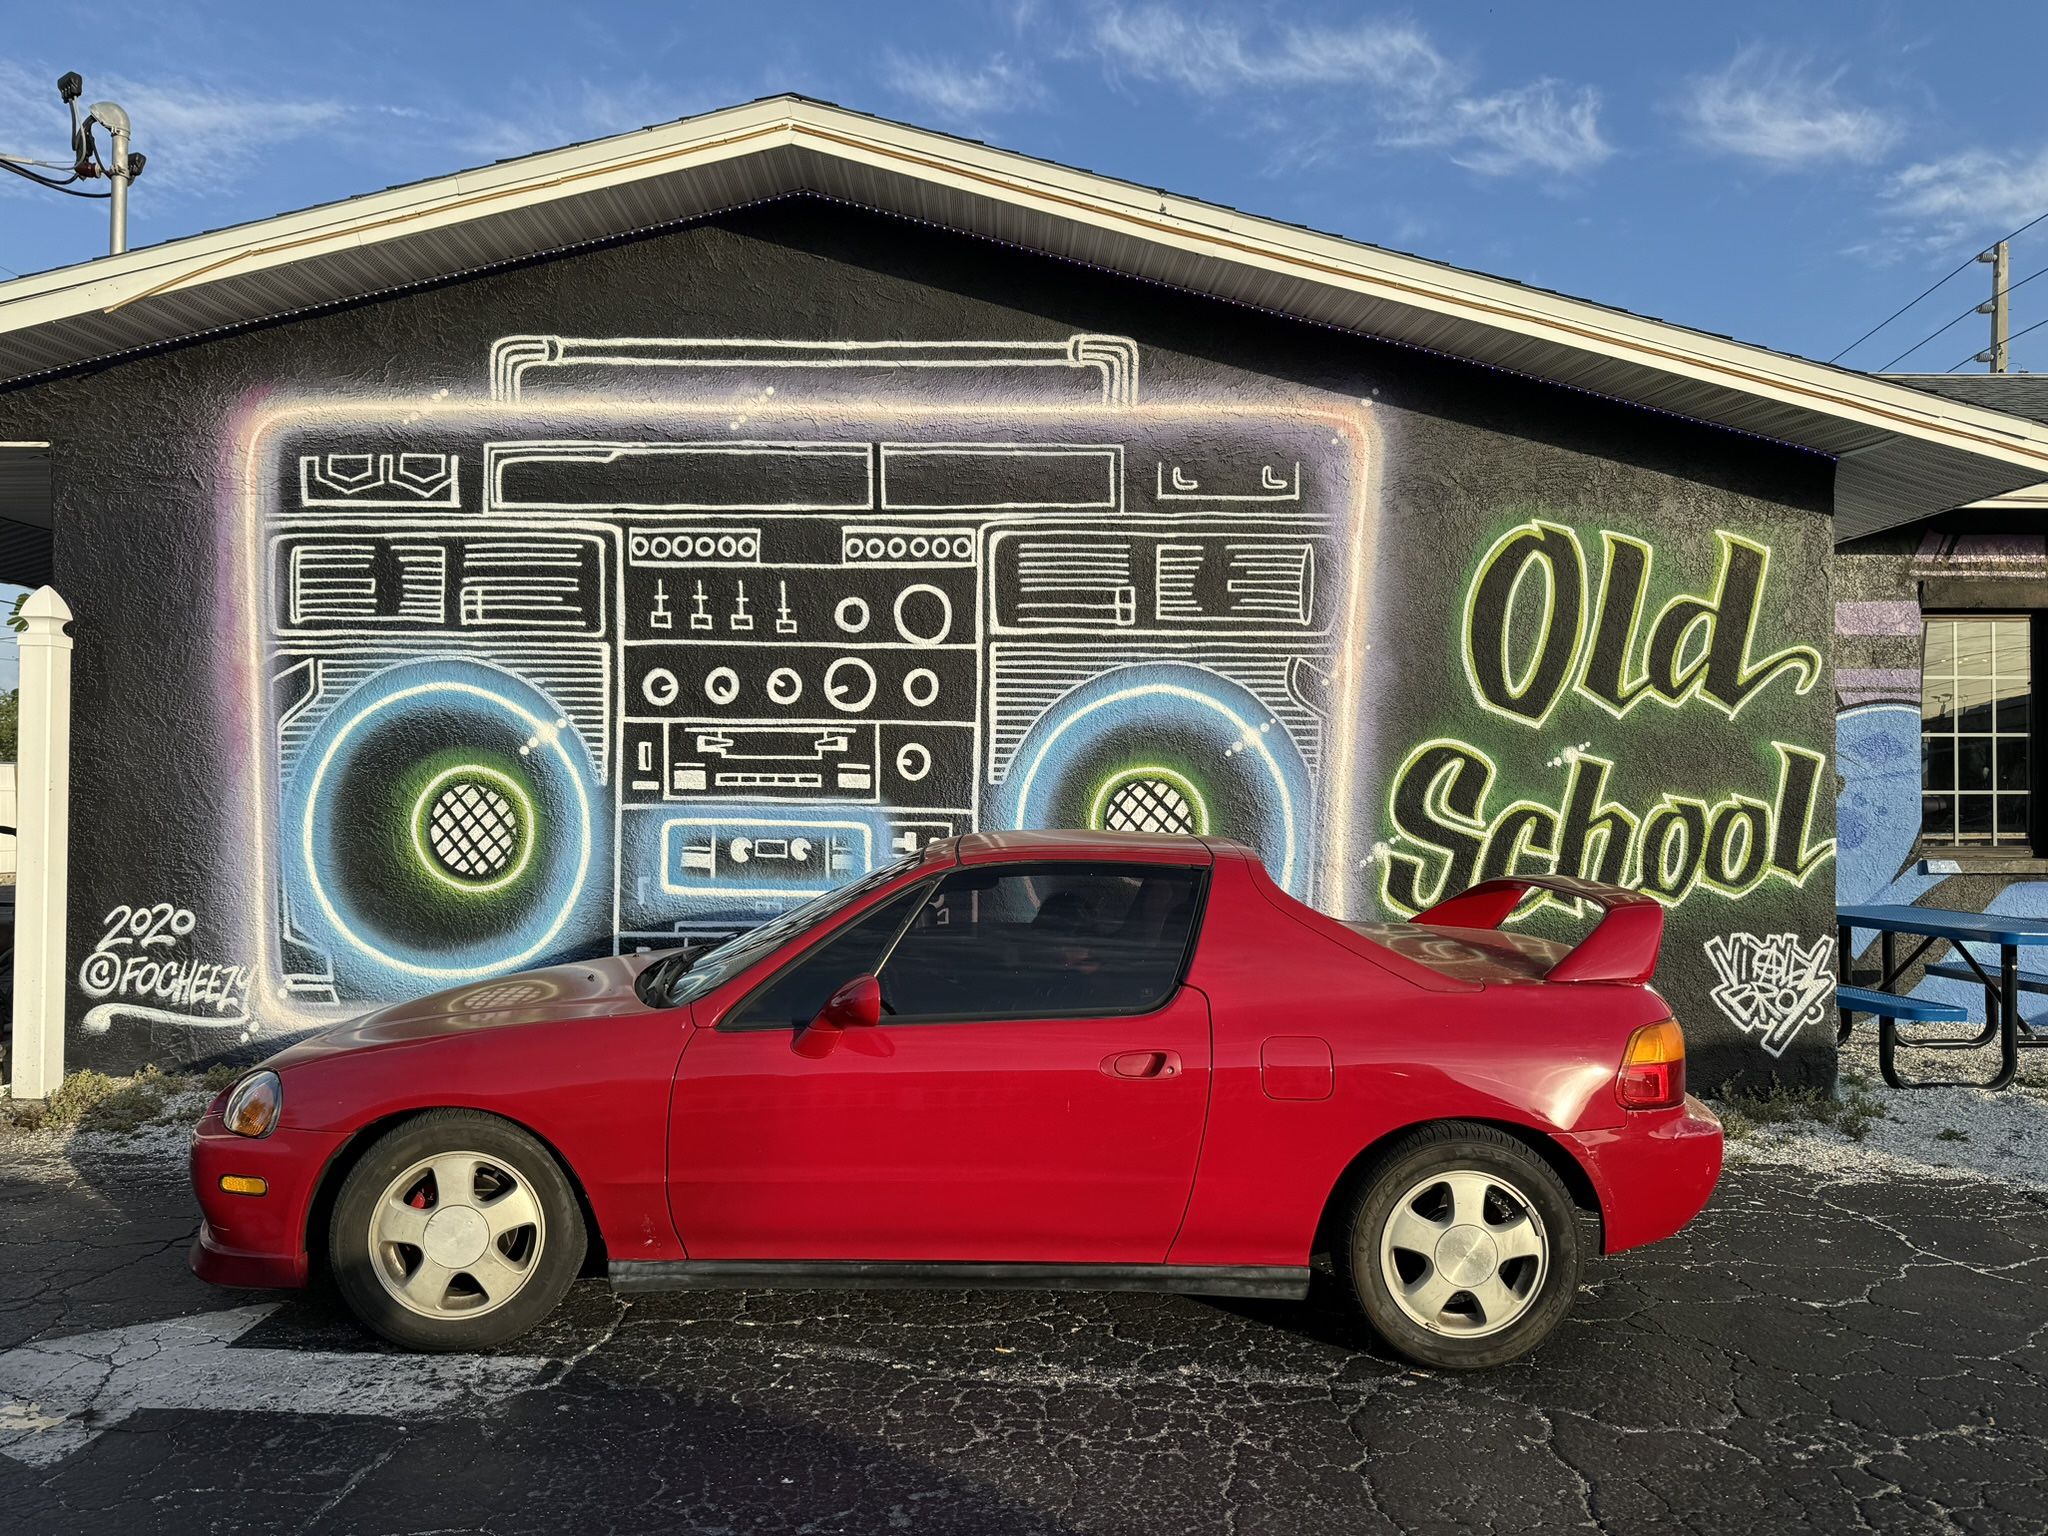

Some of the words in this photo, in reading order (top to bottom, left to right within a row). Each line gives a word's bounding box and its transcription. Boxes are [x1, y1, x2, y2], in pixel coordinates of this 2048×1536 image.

[1461, 519, 1823, 729] Old
[1380, 738, 1837, 921] School
[95, 902, 197, 952] 2020
